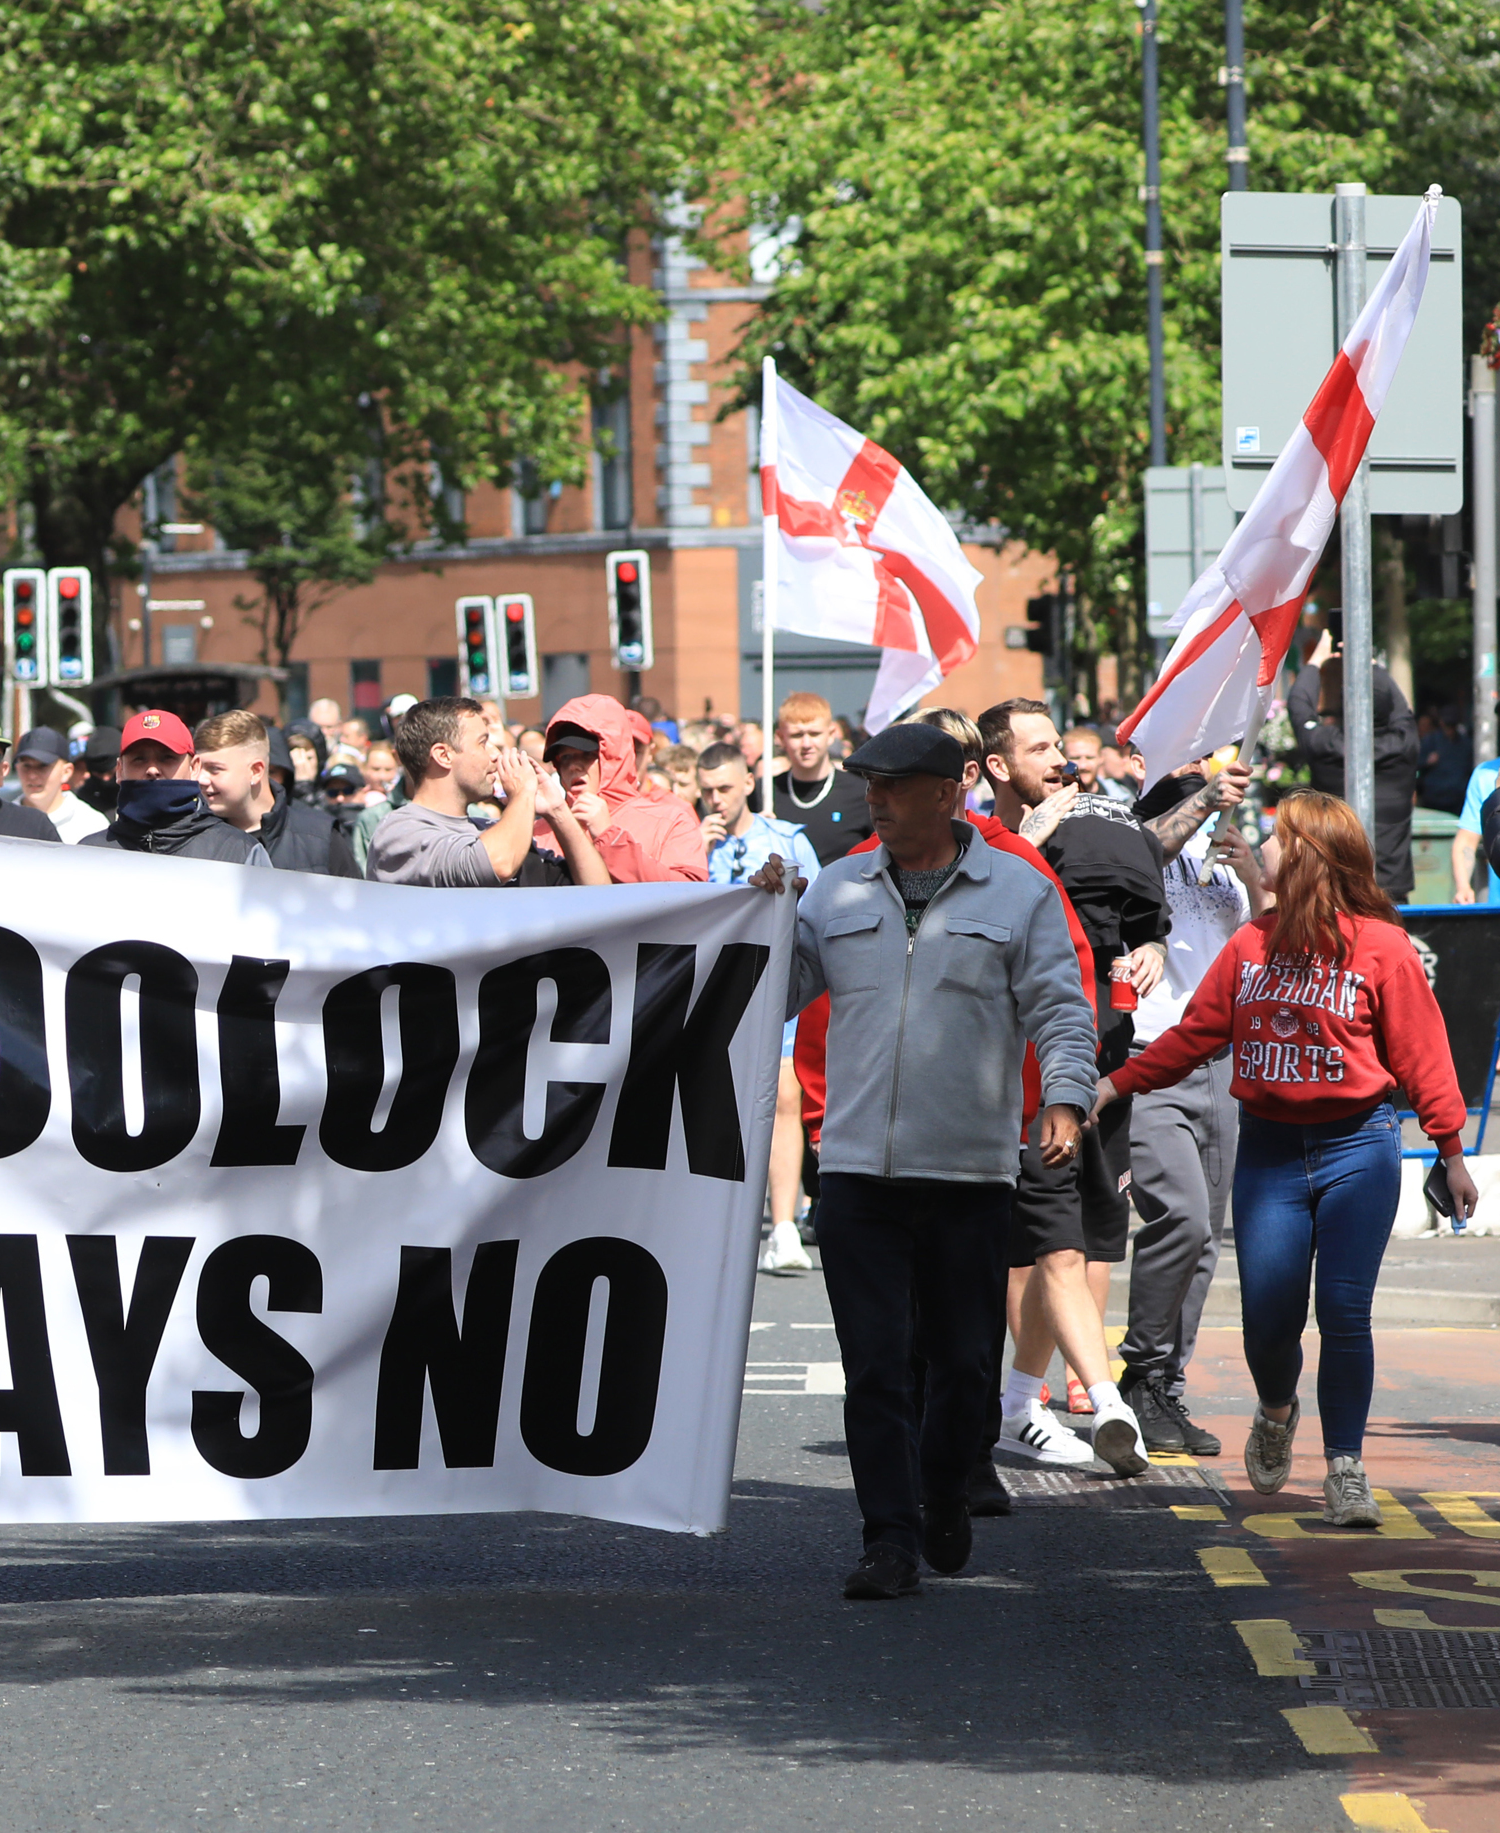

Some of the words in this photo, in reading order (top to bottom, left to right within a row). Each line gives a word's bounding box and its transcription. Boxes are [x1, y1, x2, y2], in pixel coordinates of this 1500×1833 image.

[1091, 798, 1132, 813] adidas
[1235, 960, 1366, 1022] MICHIGAN
[1239, 1041, 1344, 1083] SPORTS
[373, 1236, 668, 1476] NO
